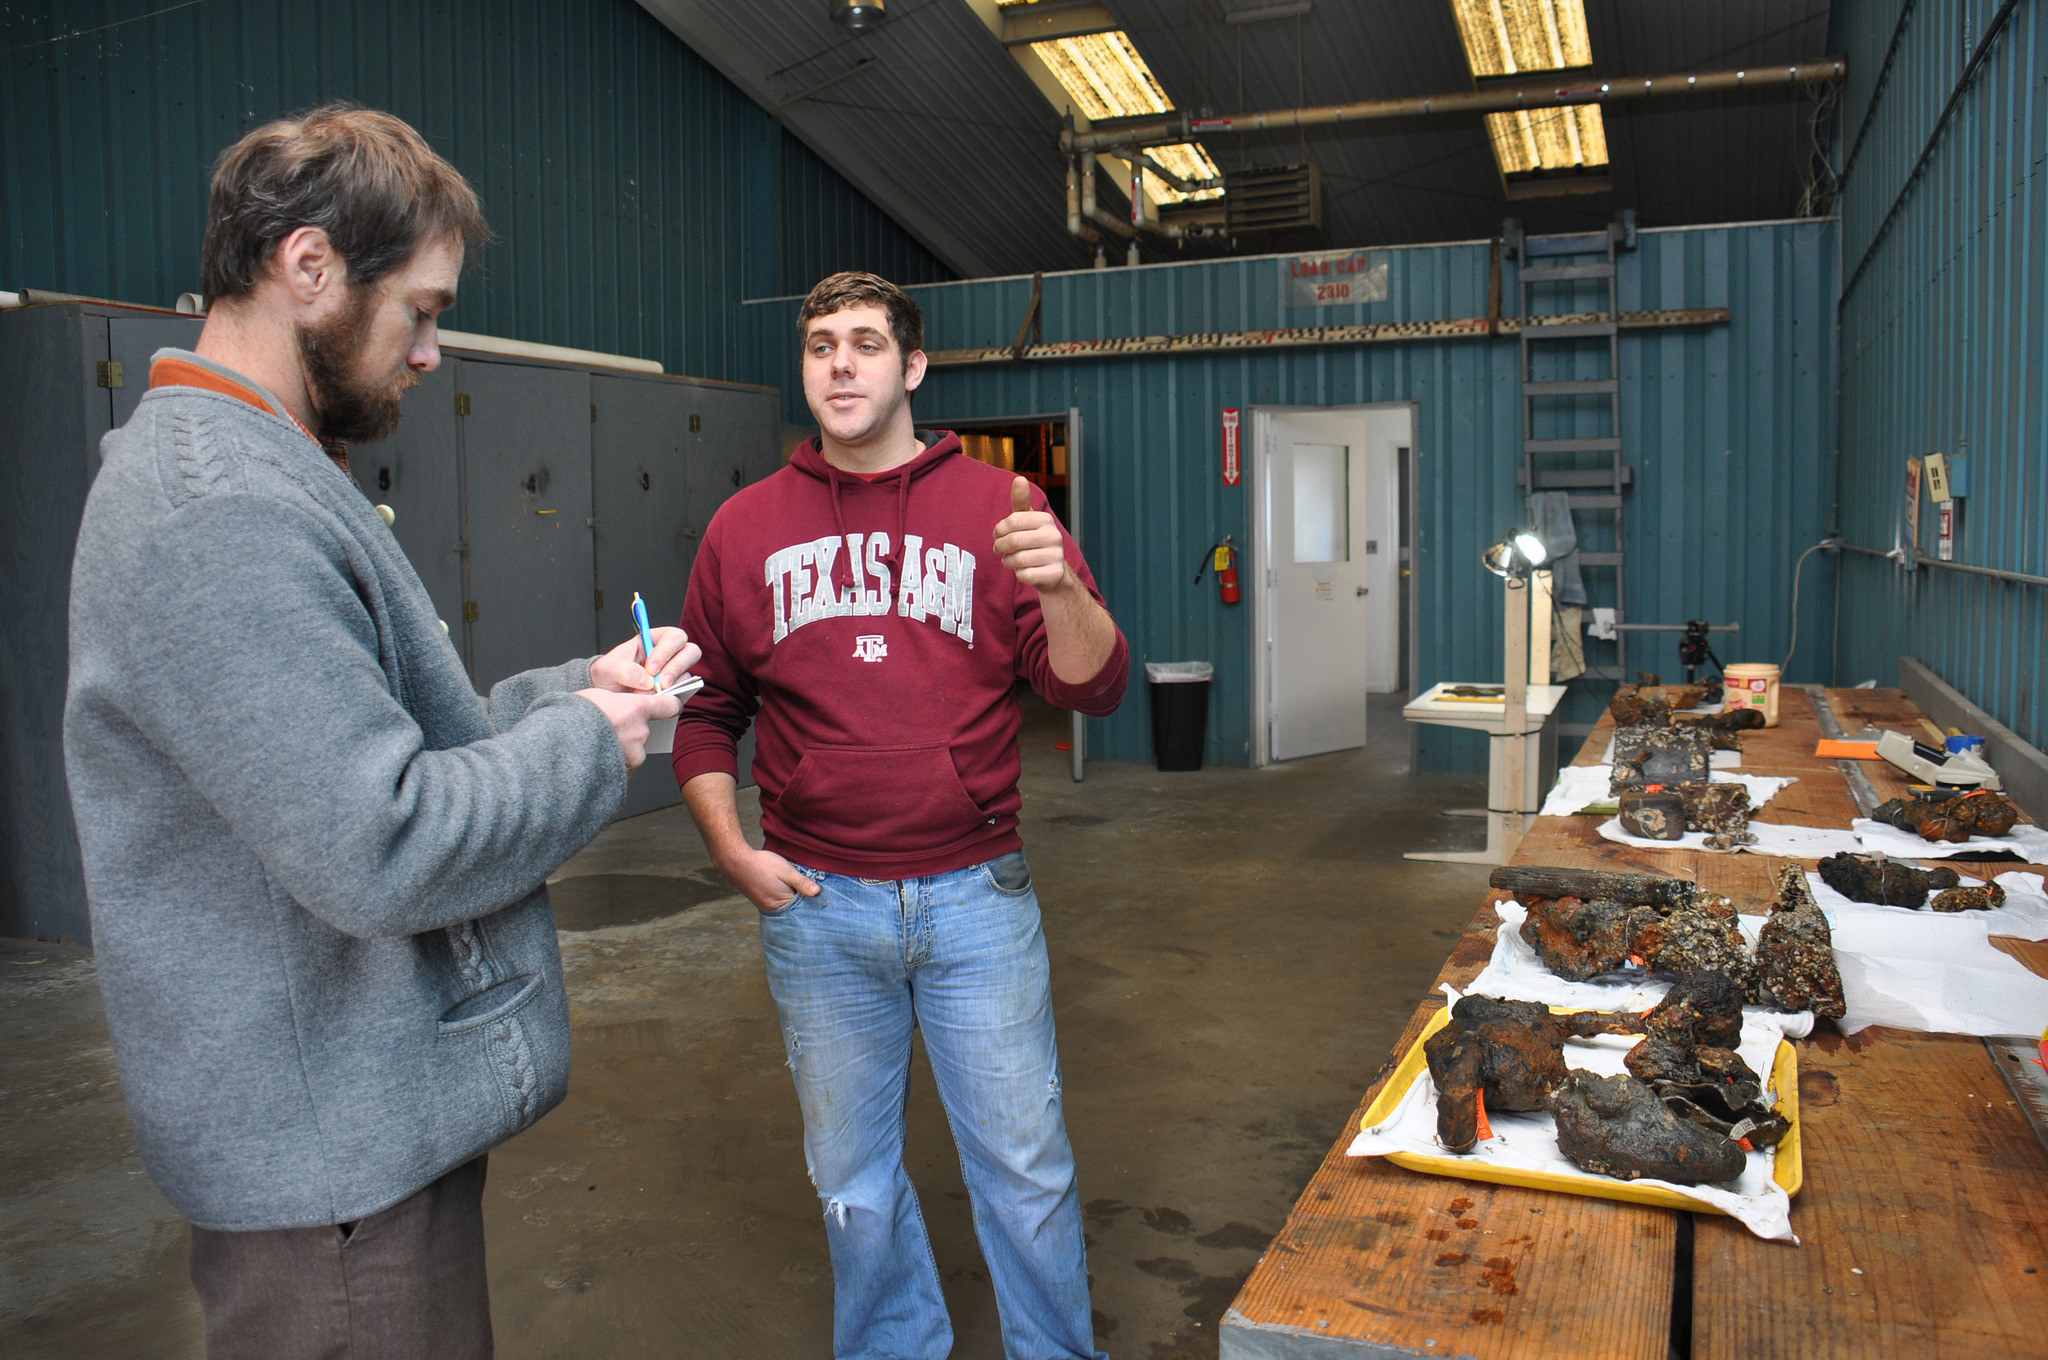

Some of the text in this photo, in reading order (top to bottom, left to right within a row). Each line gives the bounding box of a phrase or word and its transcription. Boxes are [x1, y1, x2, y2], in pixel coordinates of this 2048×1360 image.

[1291, 260, 1330, 277] LOAD
[1317, 283, 1350, 300] 2310
[1224, 415, 1237, 424] FIRE
[764, 531, 977, 646] TEXAS A&M
